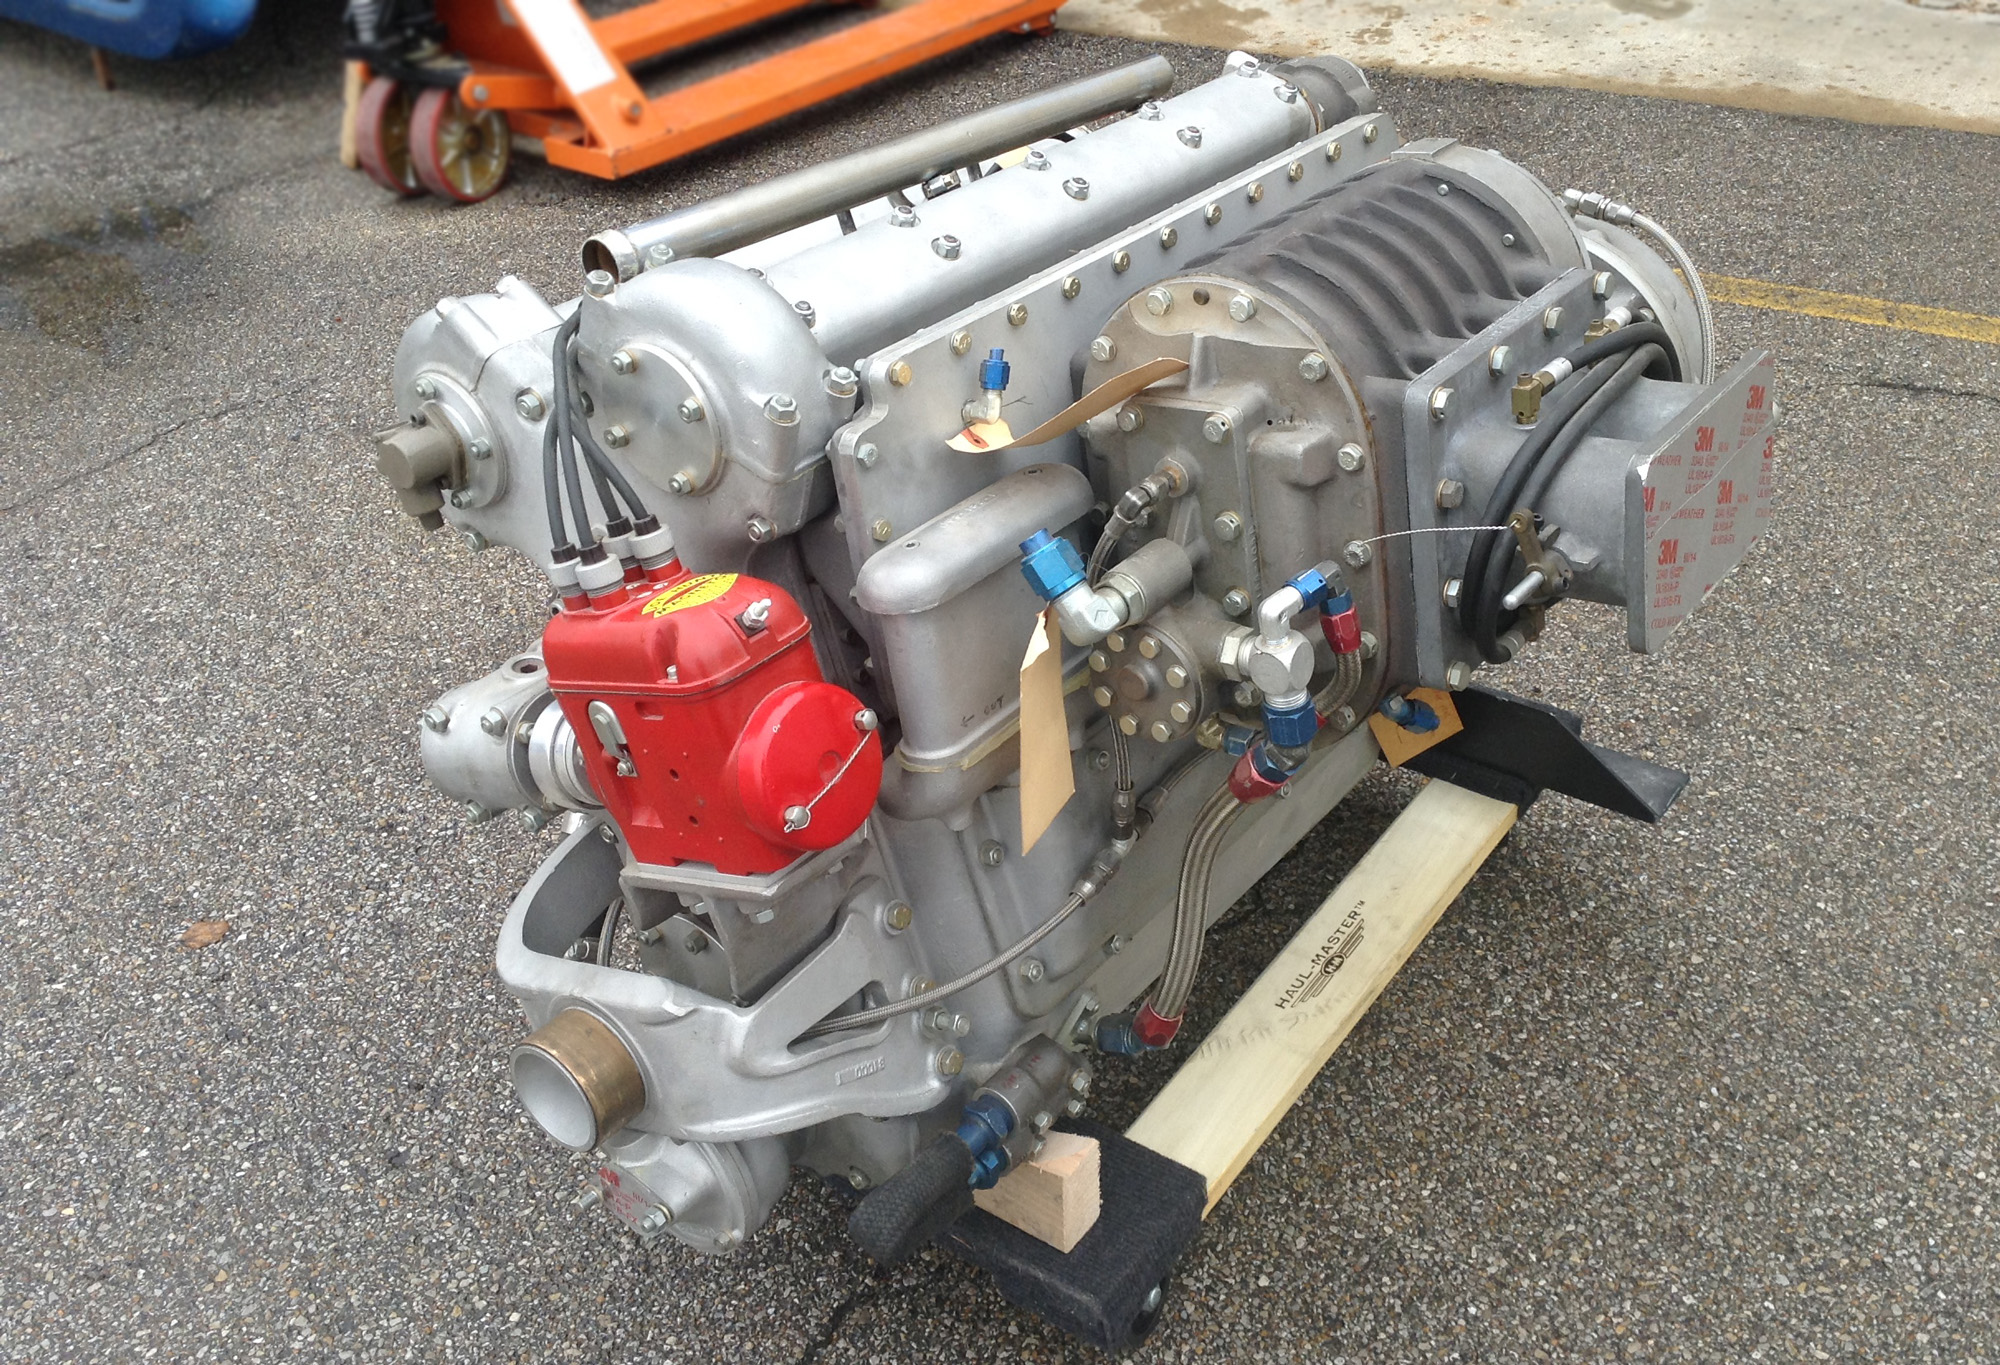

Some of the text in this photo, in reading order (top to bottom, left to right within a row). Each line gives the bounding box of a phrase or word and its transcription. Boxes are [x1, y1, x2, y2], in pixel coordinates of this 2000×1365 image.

[1746, 385, 1766, 410] 3M
[1694, 426, 1715, 451] 3M
[1763, 436, 1774, 459] 3
[1717, 480, 1734, 505] 3M
[1657, 539, 1679, 566] 3M
